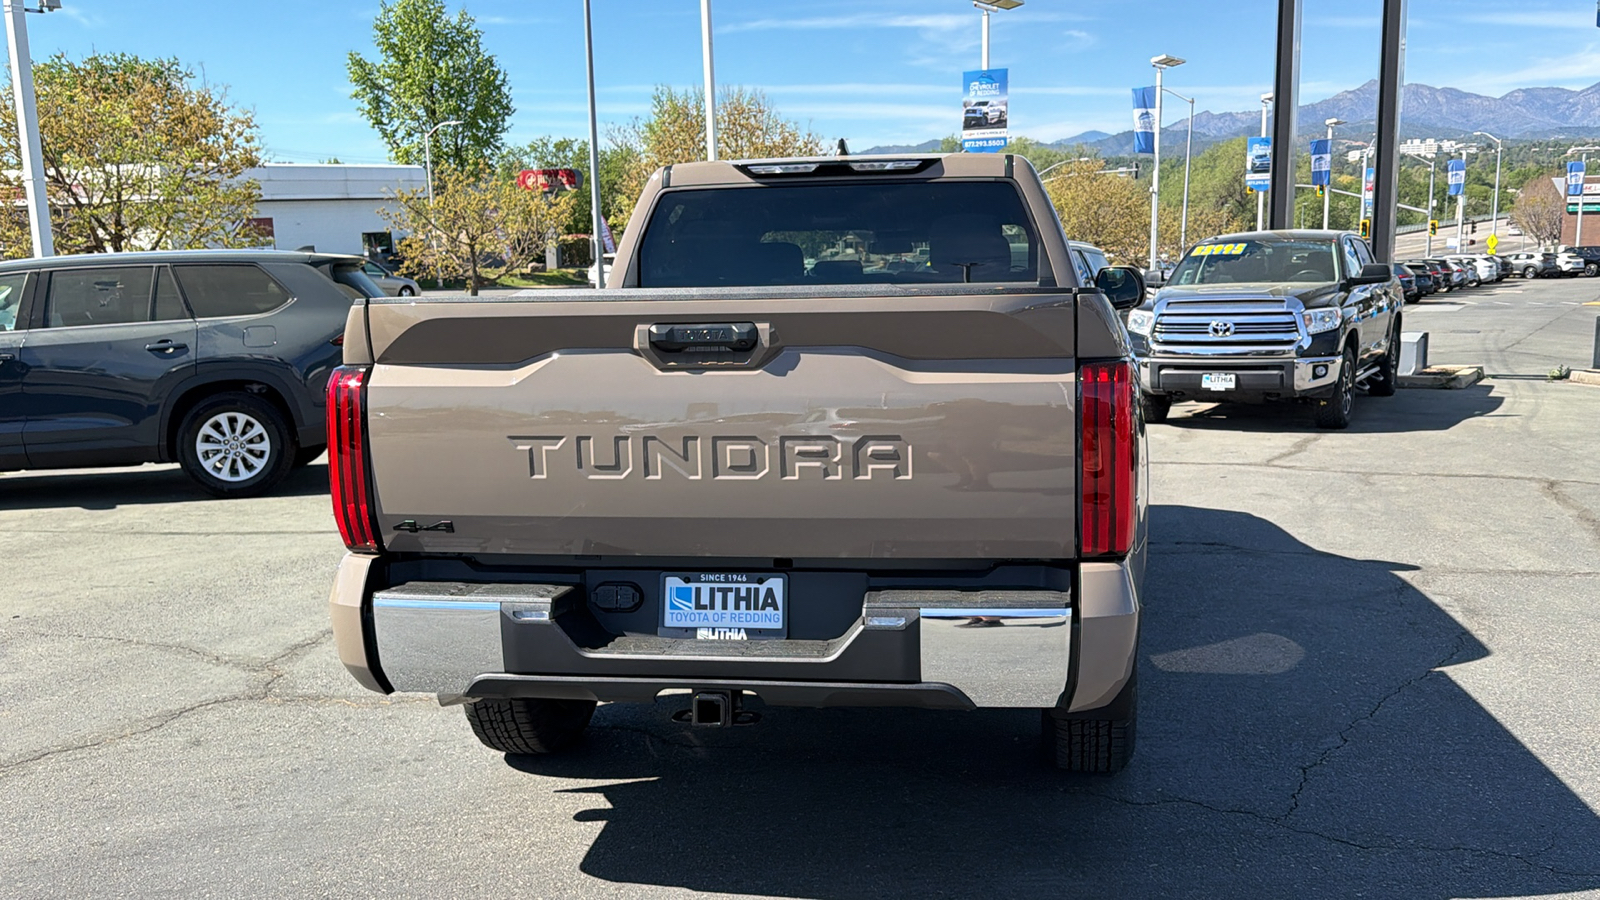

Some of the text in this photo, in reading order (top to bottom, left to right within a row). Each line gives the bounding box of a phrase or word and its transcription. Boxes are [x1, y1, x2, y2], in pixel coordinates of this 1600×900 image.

[964, 139, 1005, 148] 877.293.5503
[678, 329, 728, 341] TOYOTA
[506, 434, 913, 480] TUNDRA
[700, 574, 747, 582] SINCE 1946
[694, 586, 780, 611] LITHIA
[669, 611, 780, 624] TOYOTA OF REDDING
[708, 627, 748, 641] LITHIA
